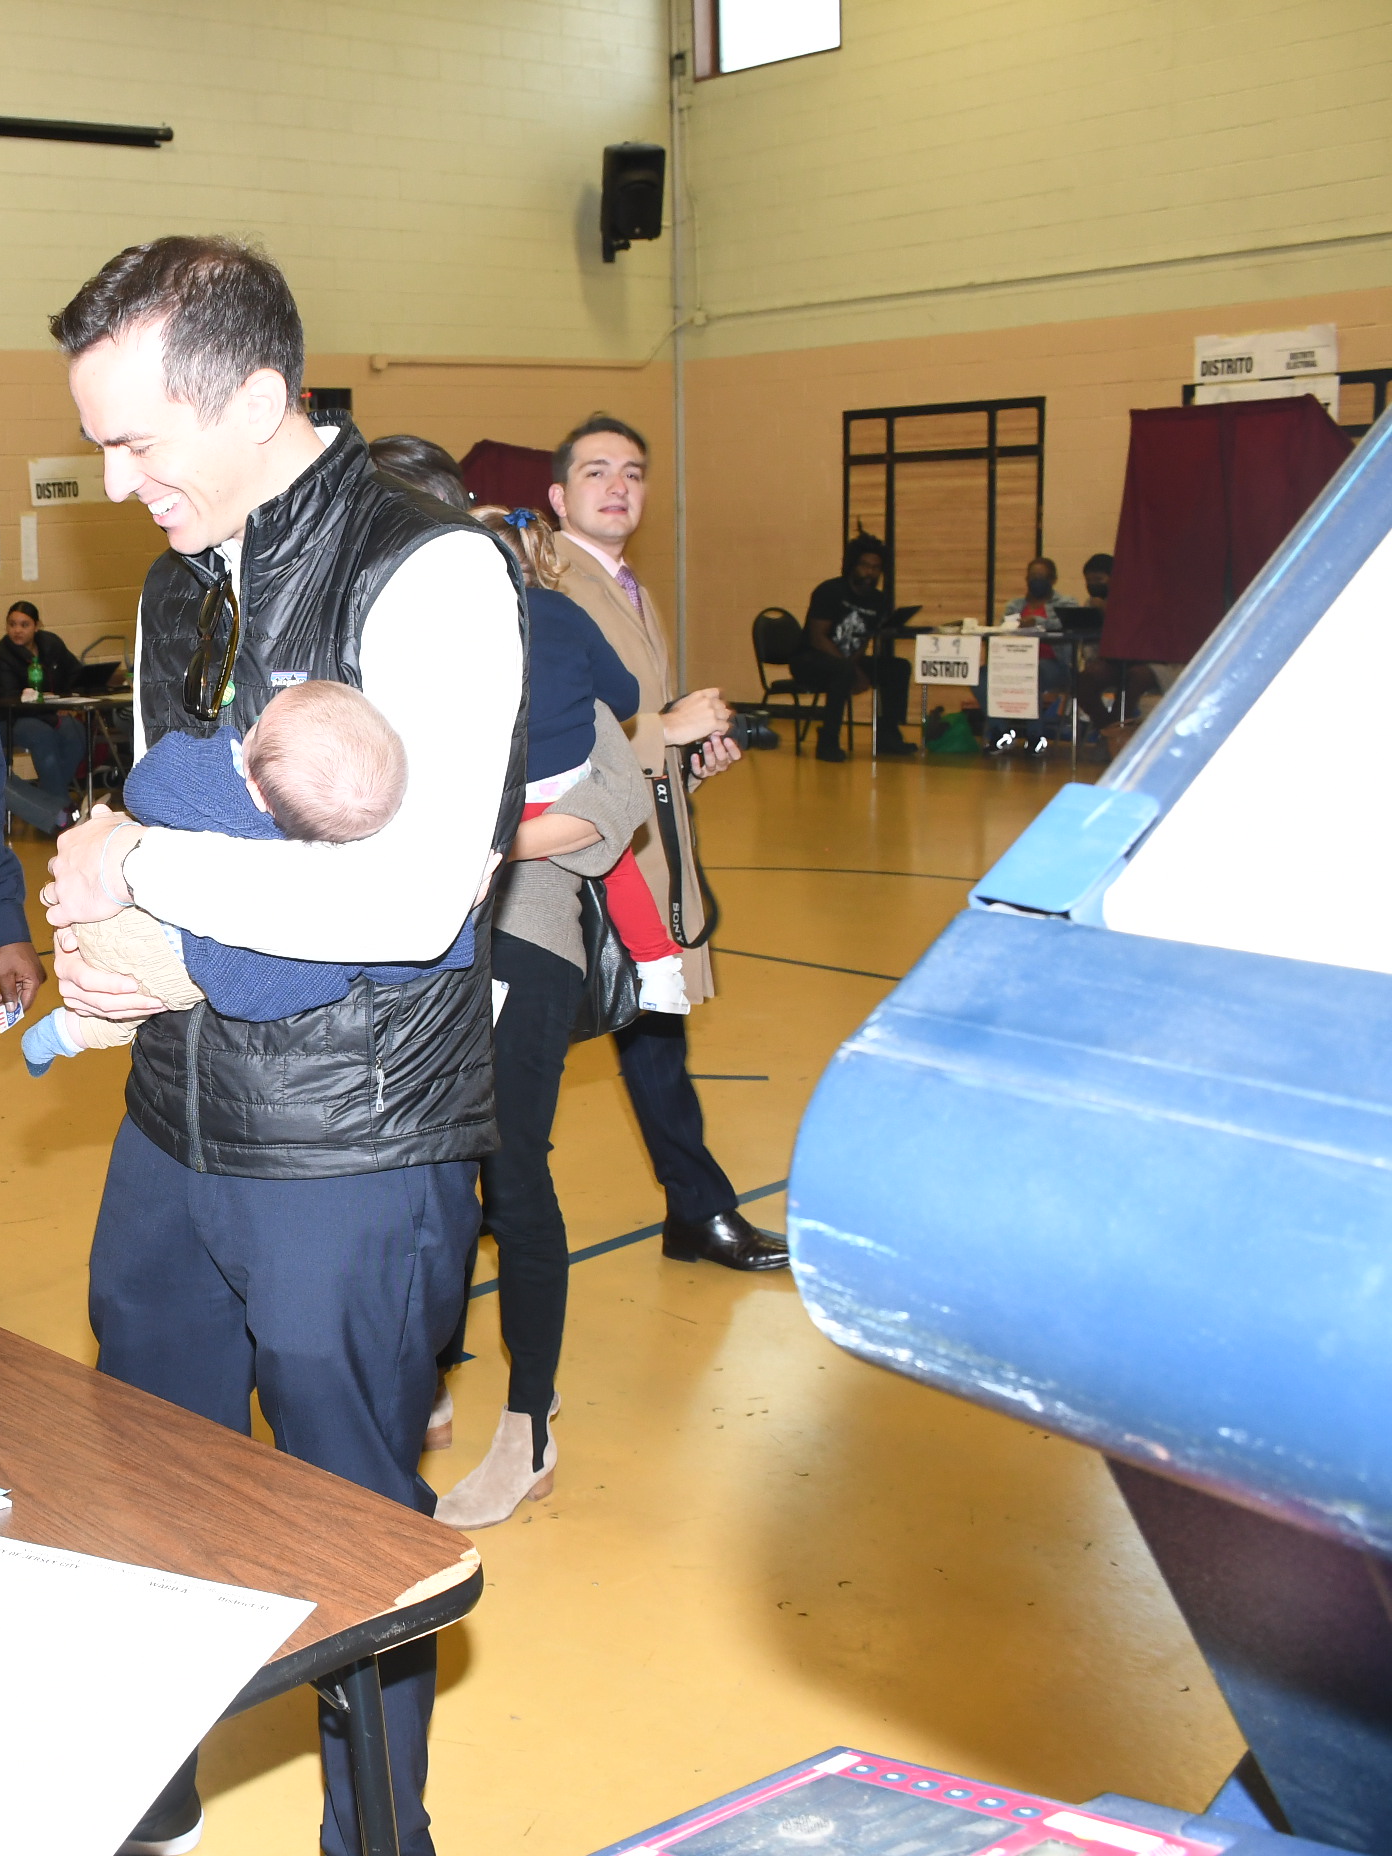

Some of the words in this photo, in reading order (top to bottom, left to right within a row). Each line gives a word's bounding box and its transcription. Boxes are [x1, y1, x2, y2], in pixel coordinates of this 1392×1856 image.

[1201, 356, 1254, 377] DISTRITO
[35, 481, 79, 499] DISTRITO
[921, 660, 969, 679] DISTRITO
[672, 902, 685, 943] SONY
